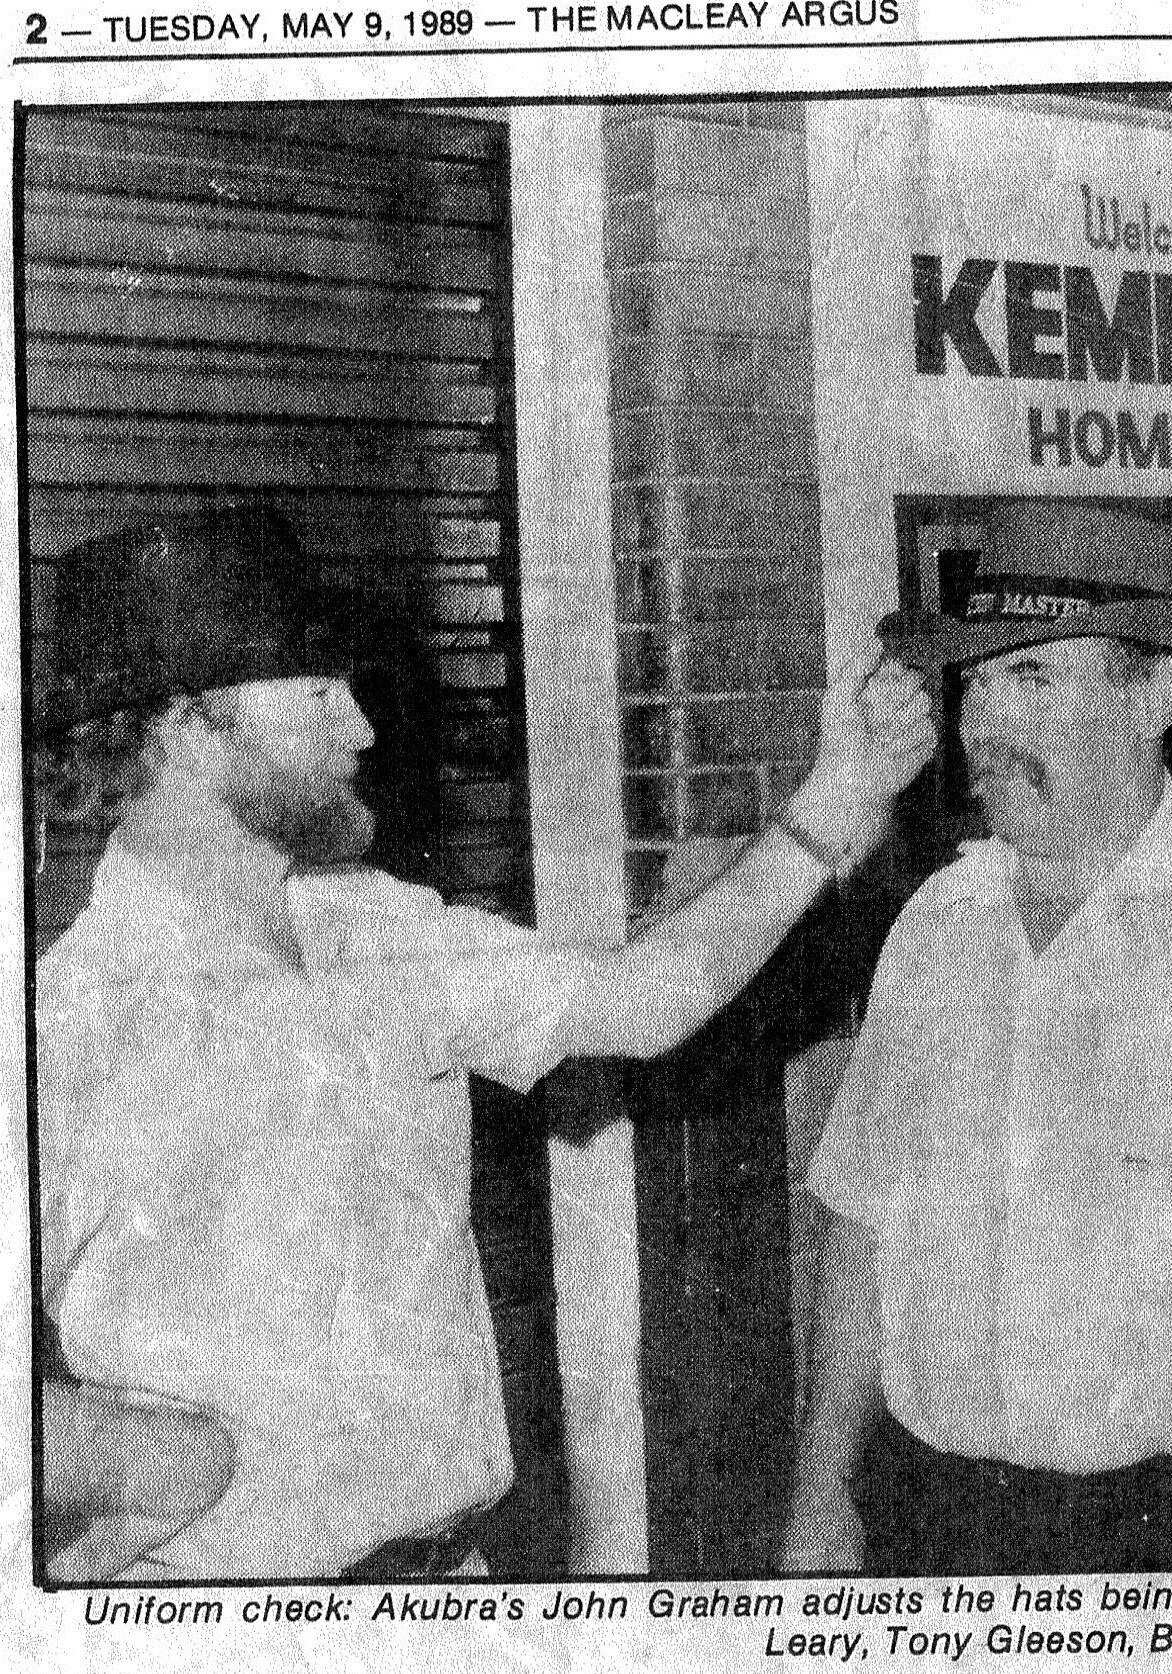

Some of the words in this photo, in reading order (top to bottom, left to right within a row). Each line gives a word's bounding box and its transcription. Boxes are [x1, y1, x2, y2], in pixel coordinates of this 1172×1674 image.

[26, 13, 48, 44] 2
[103, 13, 270, 43] TUESDAY,
[283, 13, 354, 38] MAY
[364, 11, 392, 41] 9,
[405, 10, 474, 36] 1989
[528, 6, 596, 31] THE
[607, 2, 769, 30] MACLEAY
[782, 0, 900, 26] ARGUS
[85, 1596, 224, 1625] Uniform
[243, 1594, 354, 1622] check:
[372, 1592, 525, 1621] Akubra's
[542, 1591, 628, 1620] John
[648, 1588, 785, 1618] Graham
[802, 1587, 924, 1621] adjusts
[942, 1585, 996, 1613] the
[1012, 1583, 1083, 1612] hats
[765, 1628, 869, 1662] Leary,
[887, 1626, 973, 1661] Tony
[987, 1624, 1134, 1656] Gleeson,
